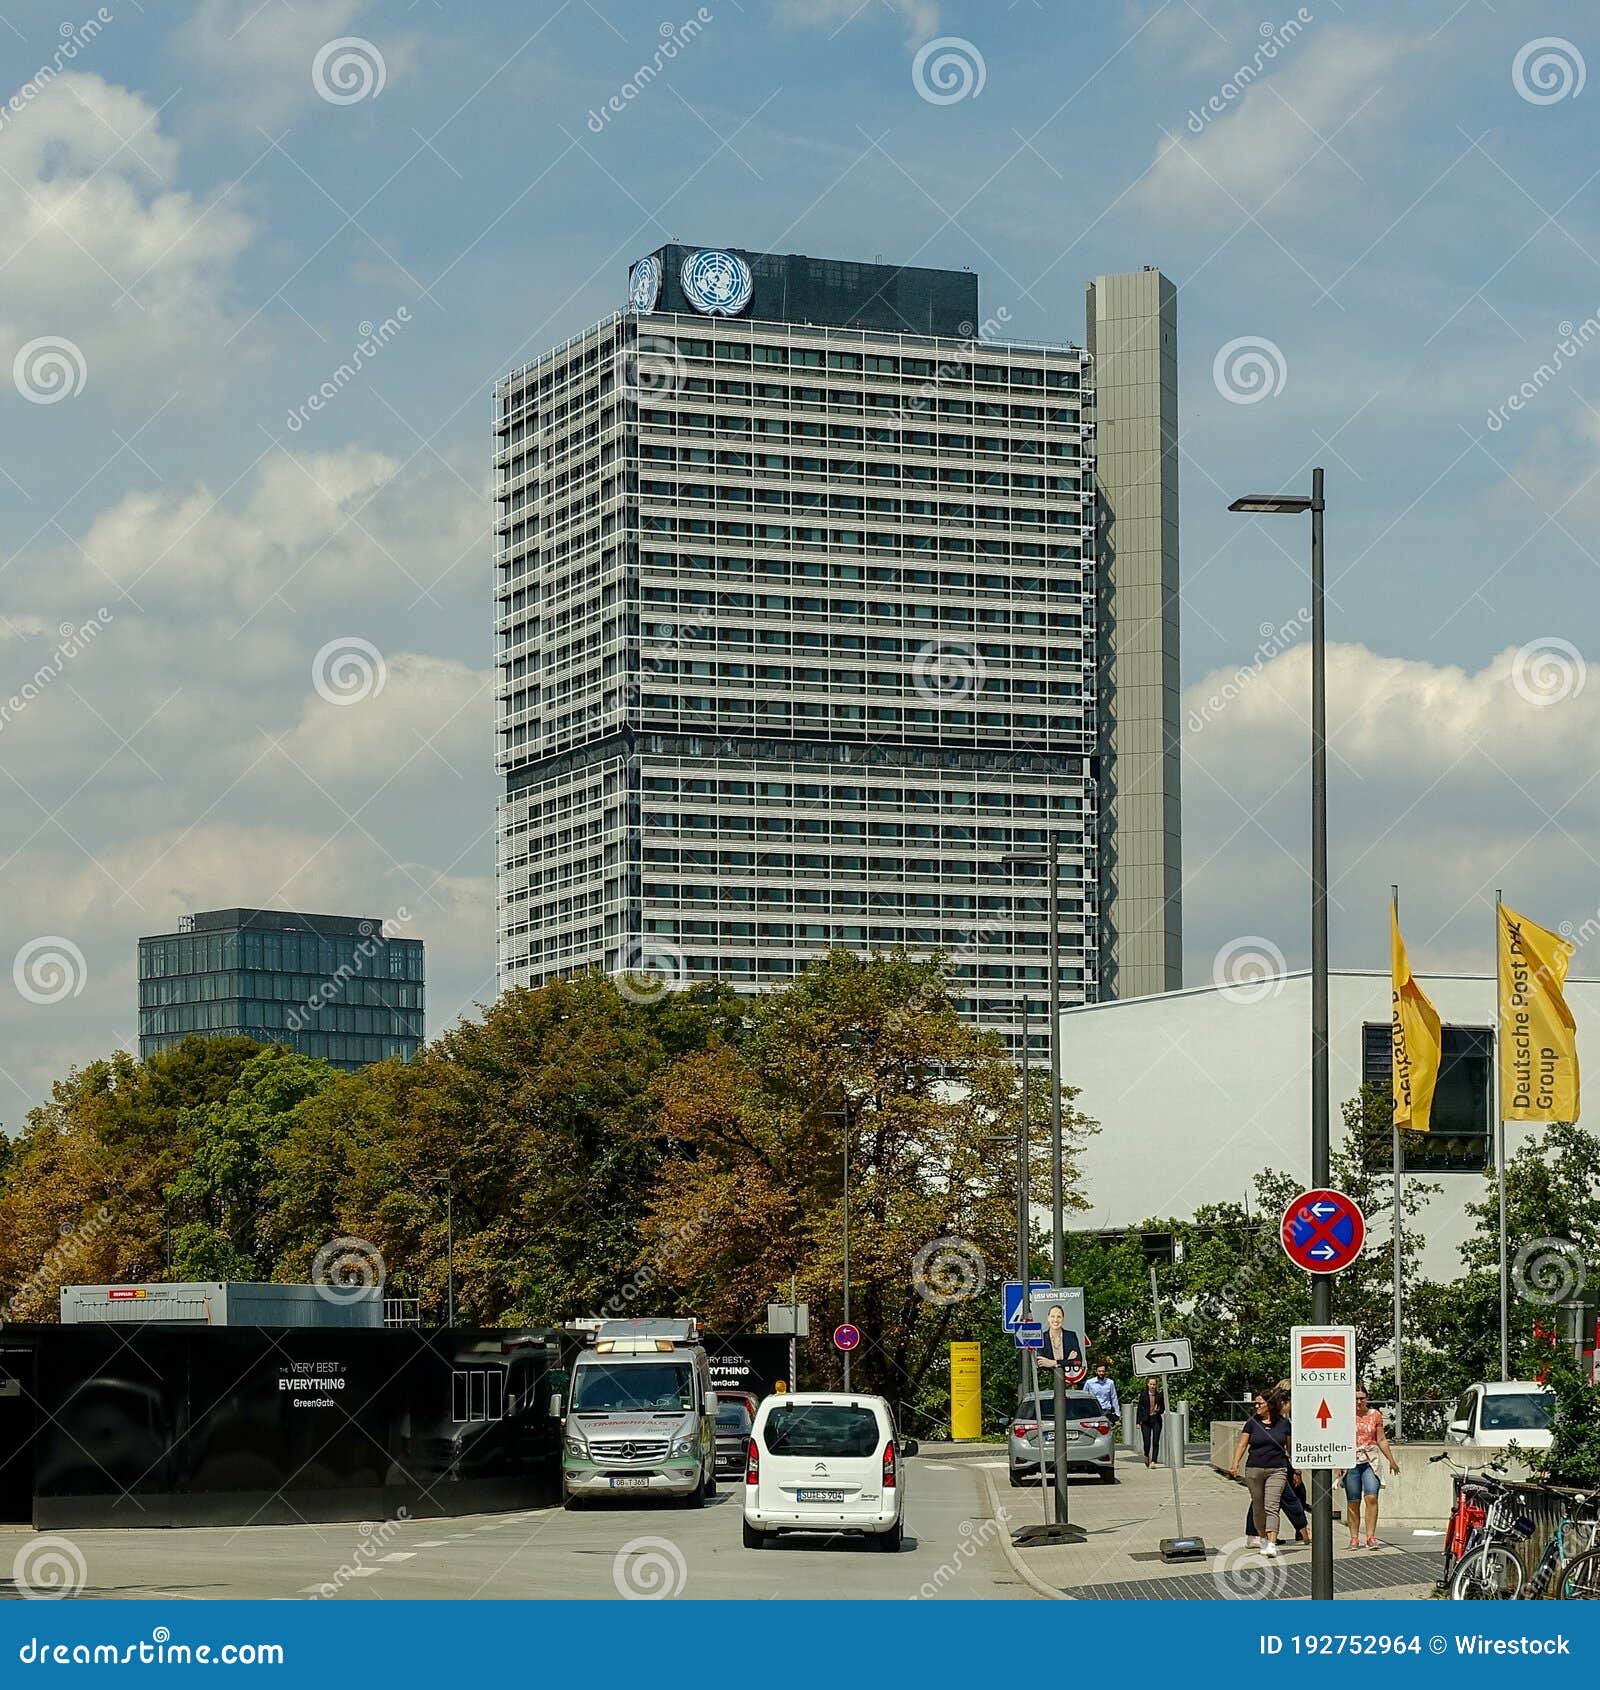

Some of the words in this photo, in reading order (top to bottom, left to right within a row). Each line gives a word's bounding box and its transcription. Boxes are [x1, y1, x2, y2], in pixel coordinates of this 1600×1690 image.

[1510, 961, 1529, 1006] Post
[1512, 1012, 1530, 1109] Deutsche
[1536, 1047, 1559, 1110] Group
[722, 1356, 744, 1364] BEST
[290, 1362, 315, 1372] VERY
[316, 1362, 340, 1373] BEST
[709, 1366, 750, 1375] RYTHING
[1300, 1371, 1347, 1382] KÖSTER
[278, 1378, 345, 1390] EVERYTHING
[293, 1398, 335, 1408] GreenGate
[1295, 1442, 1353, 1453] Baustellen-
[1295, 1453, 1332, 1463] zufahrt
[802, 1490, 812, 1499] SU
[816, 1490, 827, 1499] ES
